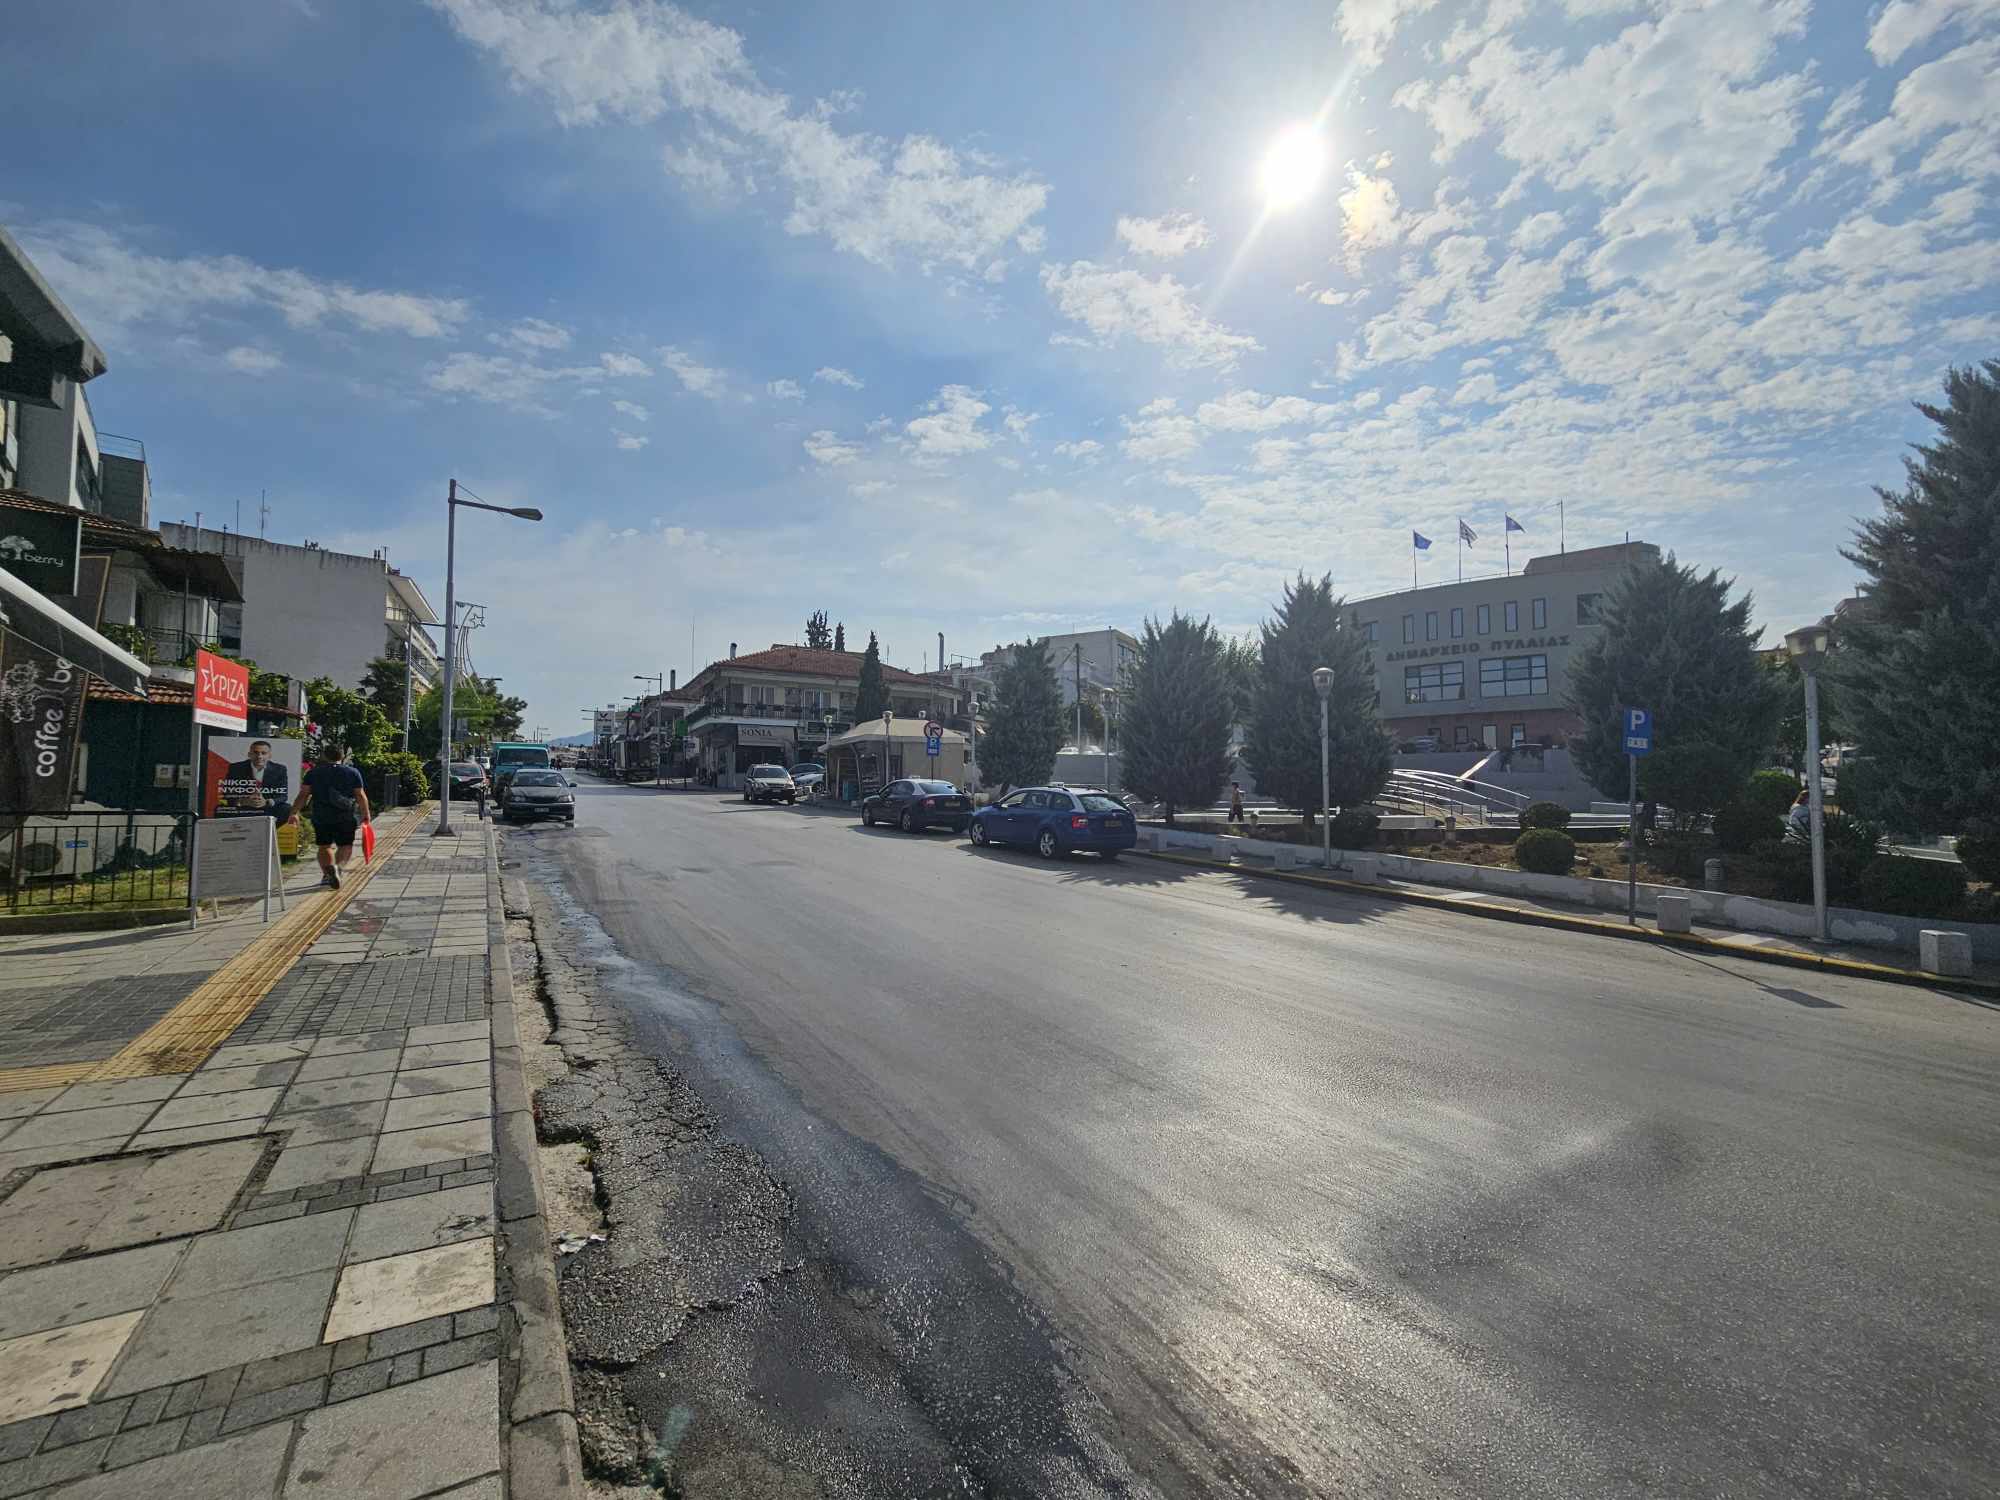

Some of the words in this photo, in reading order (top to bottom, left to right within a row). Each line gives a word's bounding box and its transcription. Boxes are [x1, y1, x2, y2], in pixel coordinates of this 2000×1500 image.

[24, 551, 64, 568] berry
[1631, 709, 1646, 731] P
[741, 727, 773, 737] SONIA
[34, 708, 64, 777] coffee
[218, 786, 288, 794] ΝΥΦΟΥΔΗΣ
